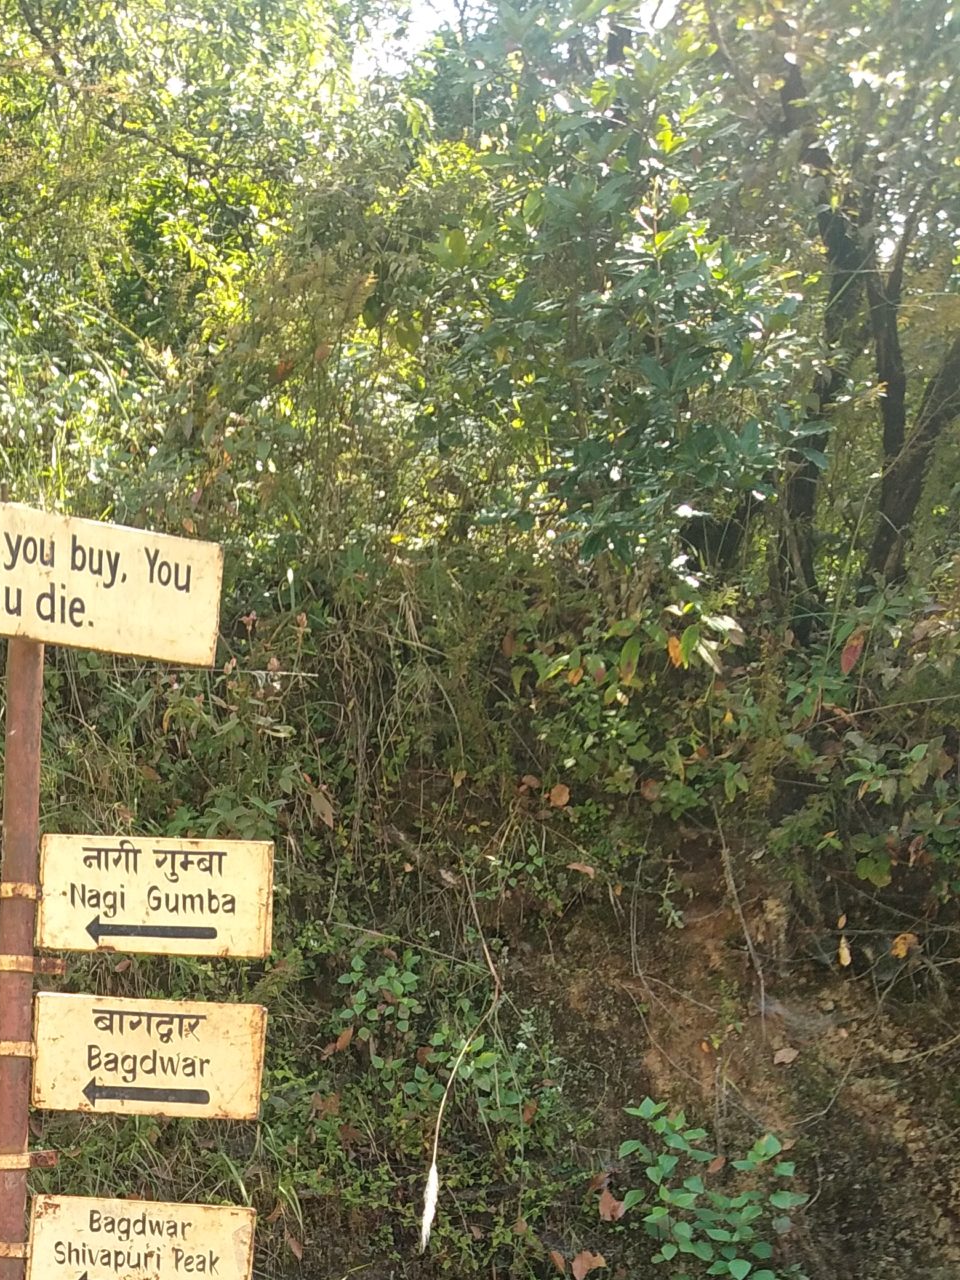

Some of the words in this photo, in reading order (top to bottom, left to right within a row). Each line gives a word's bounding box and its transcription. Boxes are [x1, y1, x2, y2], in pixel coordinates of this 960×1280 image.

[3, 531, 55, 570] you
[71, 534, 127, 588] buy,
[144, 547, 192, 593] You
[36, 582, 94, 627] die.
[82, 840, 142, 874] नागी
[153, 849, 227, 883] गुम्बा
[70, 882, 126, 918] Nagi
[147, 885, 236, 915] Gumba
[92, 1009, 207, 1043] बागद्वार
[87, 1044, 210, 1083] Bagdwar
[89, 1209, 192, 1242] Bagdwar
[54, 1240, 161, 1273] Shivapuri
[171, 1246, 220, 1275] Peak
